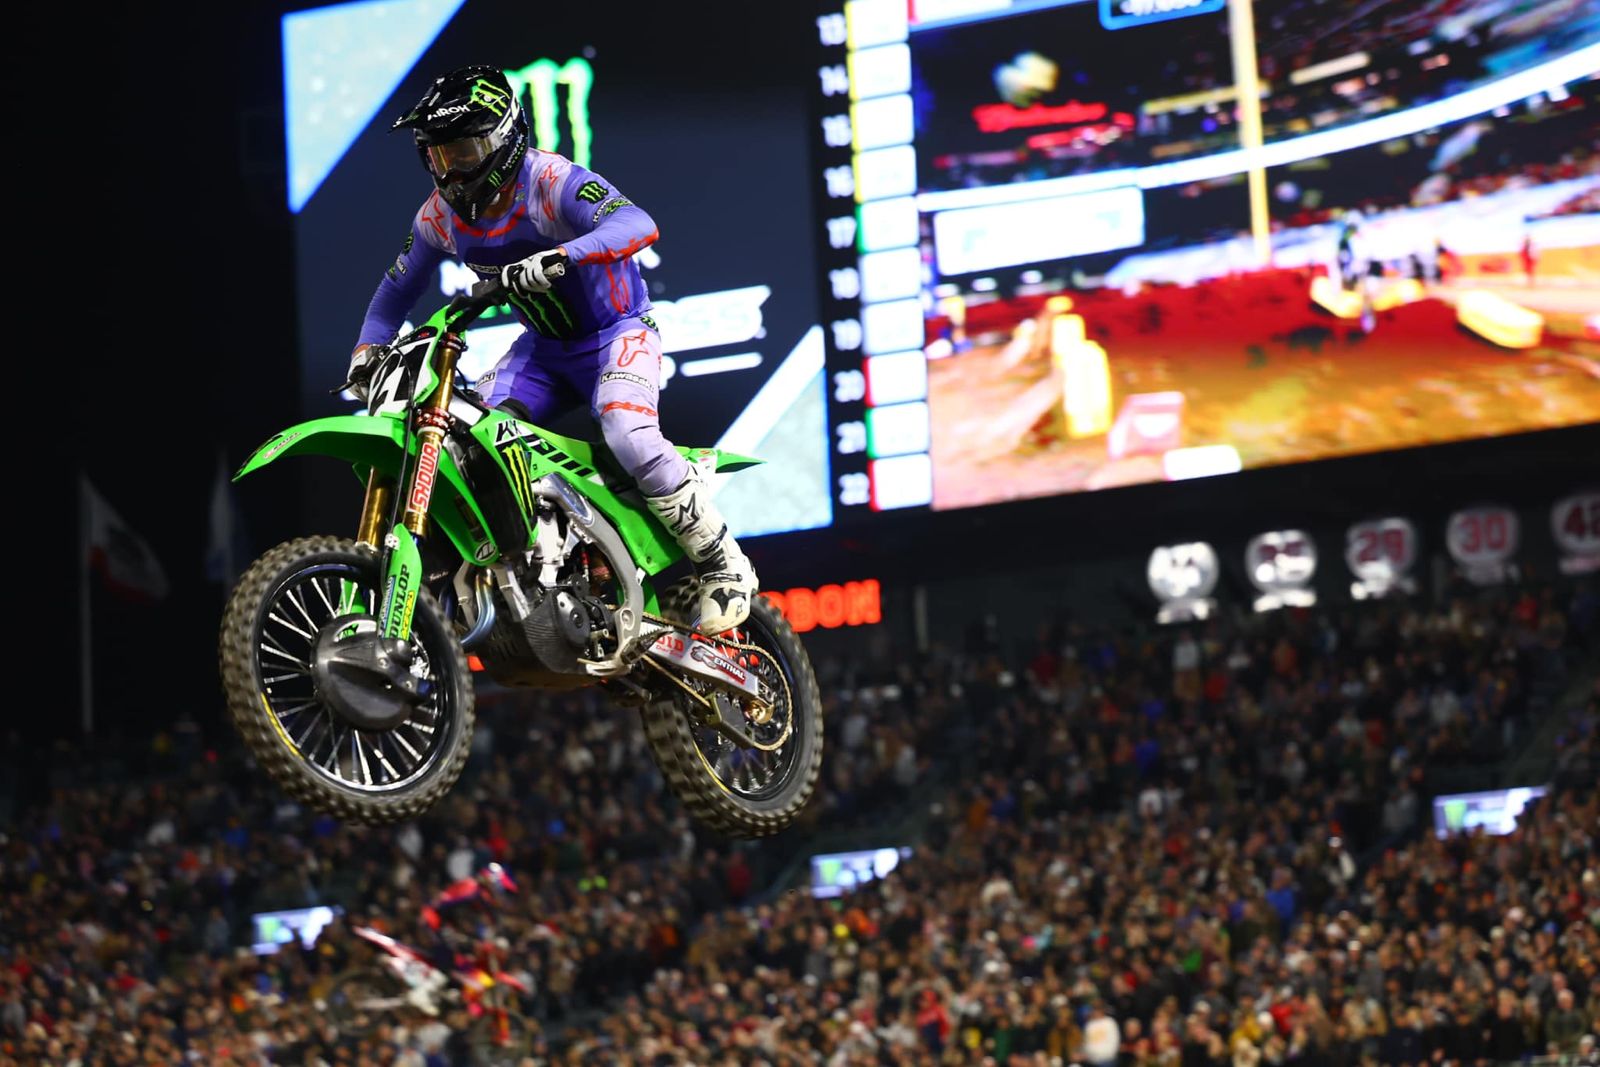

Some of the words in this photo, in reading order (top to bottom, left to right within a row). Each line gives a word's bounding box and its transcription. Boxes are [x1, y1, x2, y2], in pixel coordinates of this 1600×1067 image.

[427, 104, 471, 121] AIROH
[601, 372, 655, 393] Kawasaki
[409, 443, 440, 510] SHOWA
[1461, 512, 1508, 554] 30
[390, 563, 410, 638] DUNLOP
[690, 645, 747, 683] RENTHAL
